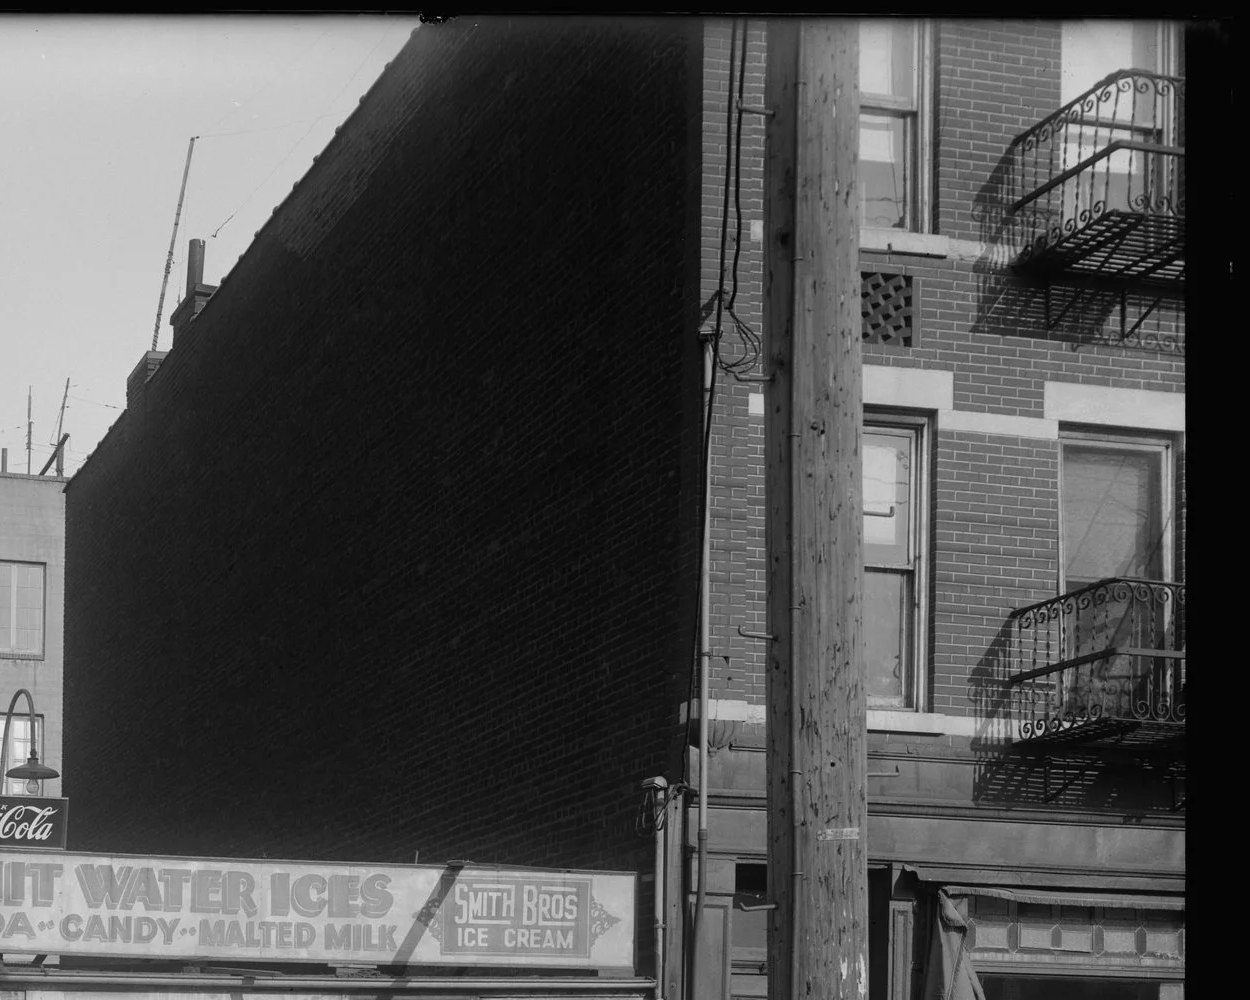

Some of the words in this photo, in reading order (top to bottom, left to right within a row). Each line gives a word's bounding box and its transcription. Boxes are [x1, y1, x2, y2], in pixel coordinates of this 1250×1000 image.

[74, 863, 259, 919] WATER
[270, 872, 394, 920] ICES
[454, 883, 515, 925] SMITH
[522, 884, 578, 926] BROS
[59, 914, 181, 946] CANDY
[199, 918, 317, 949] MALTED
[324, 923, 398, 952] MILK
[457, 927, 489, 948] ICE
[504, 928, 574, 949] CREAM
